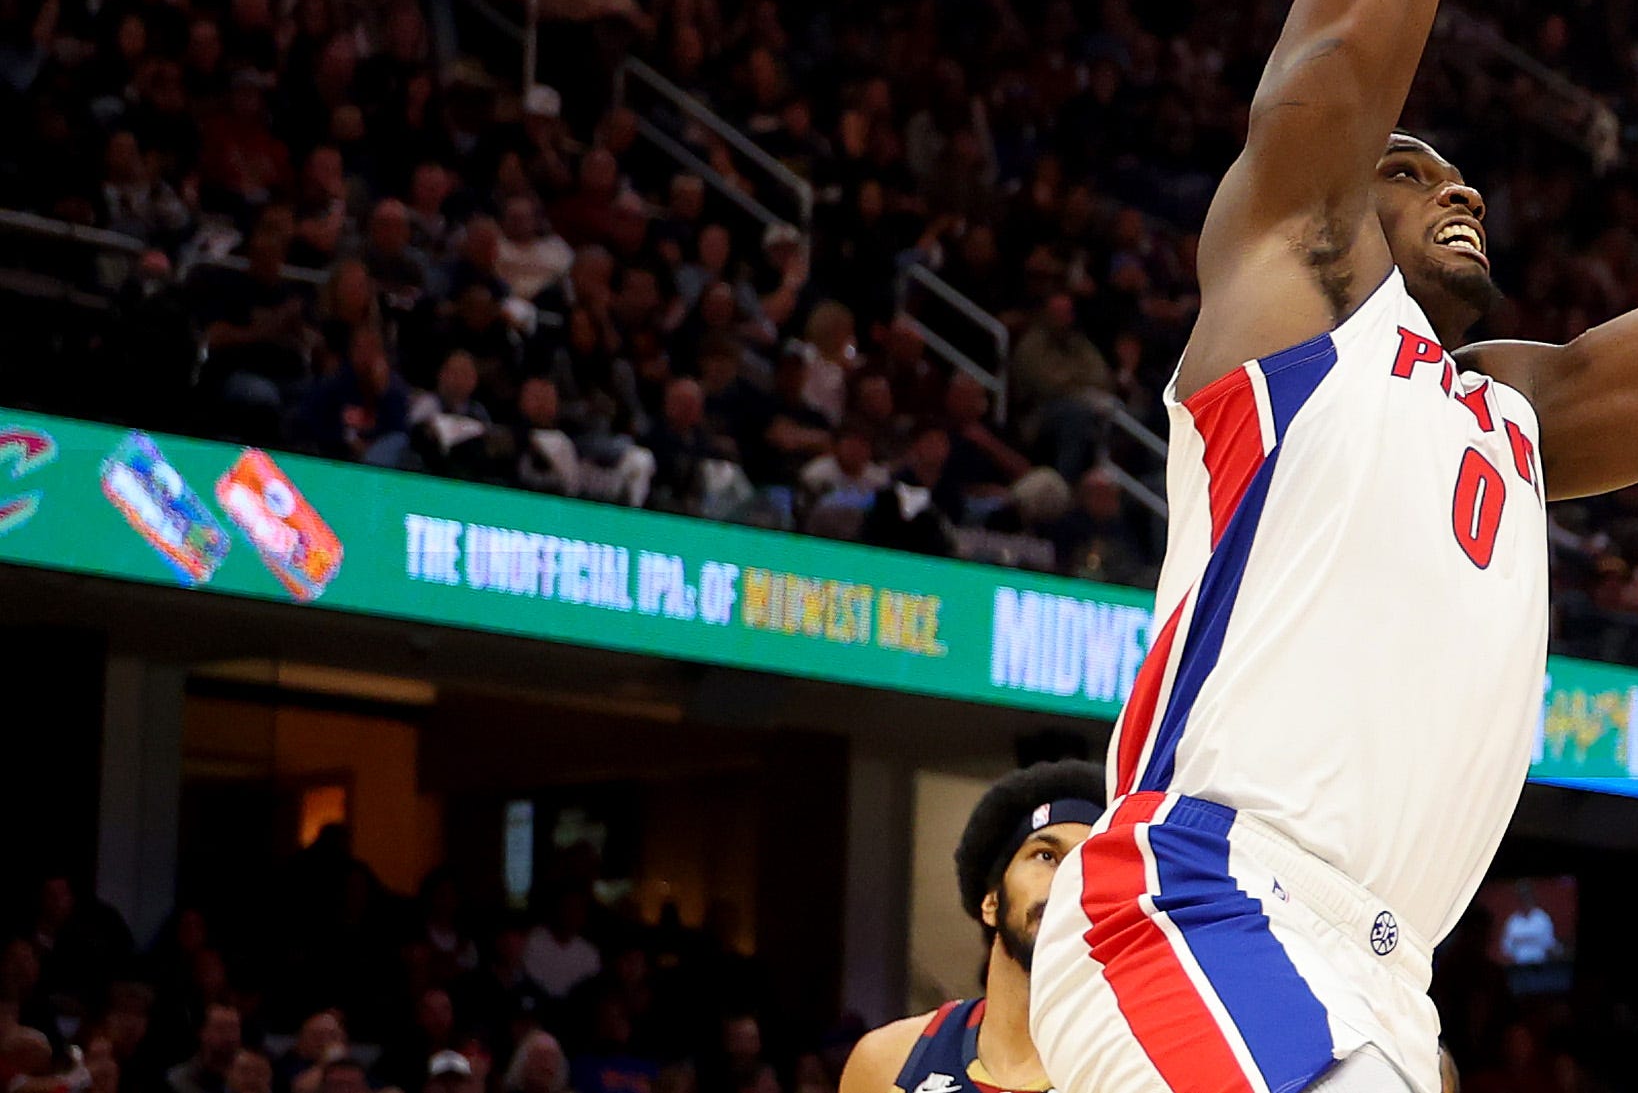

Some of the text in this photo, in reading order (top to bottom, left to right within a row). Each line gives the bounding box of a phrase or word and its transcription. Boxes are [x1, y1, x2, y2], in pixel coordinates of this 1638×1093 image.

[1452, 446, 1506, 570] 0
[405, 513, 463, 586] THE
[465, 523, 634, 612] UNOFFICIAL
[700, 561, 740, 626] OF
[991, 586, 1153, 705] MIDWE
